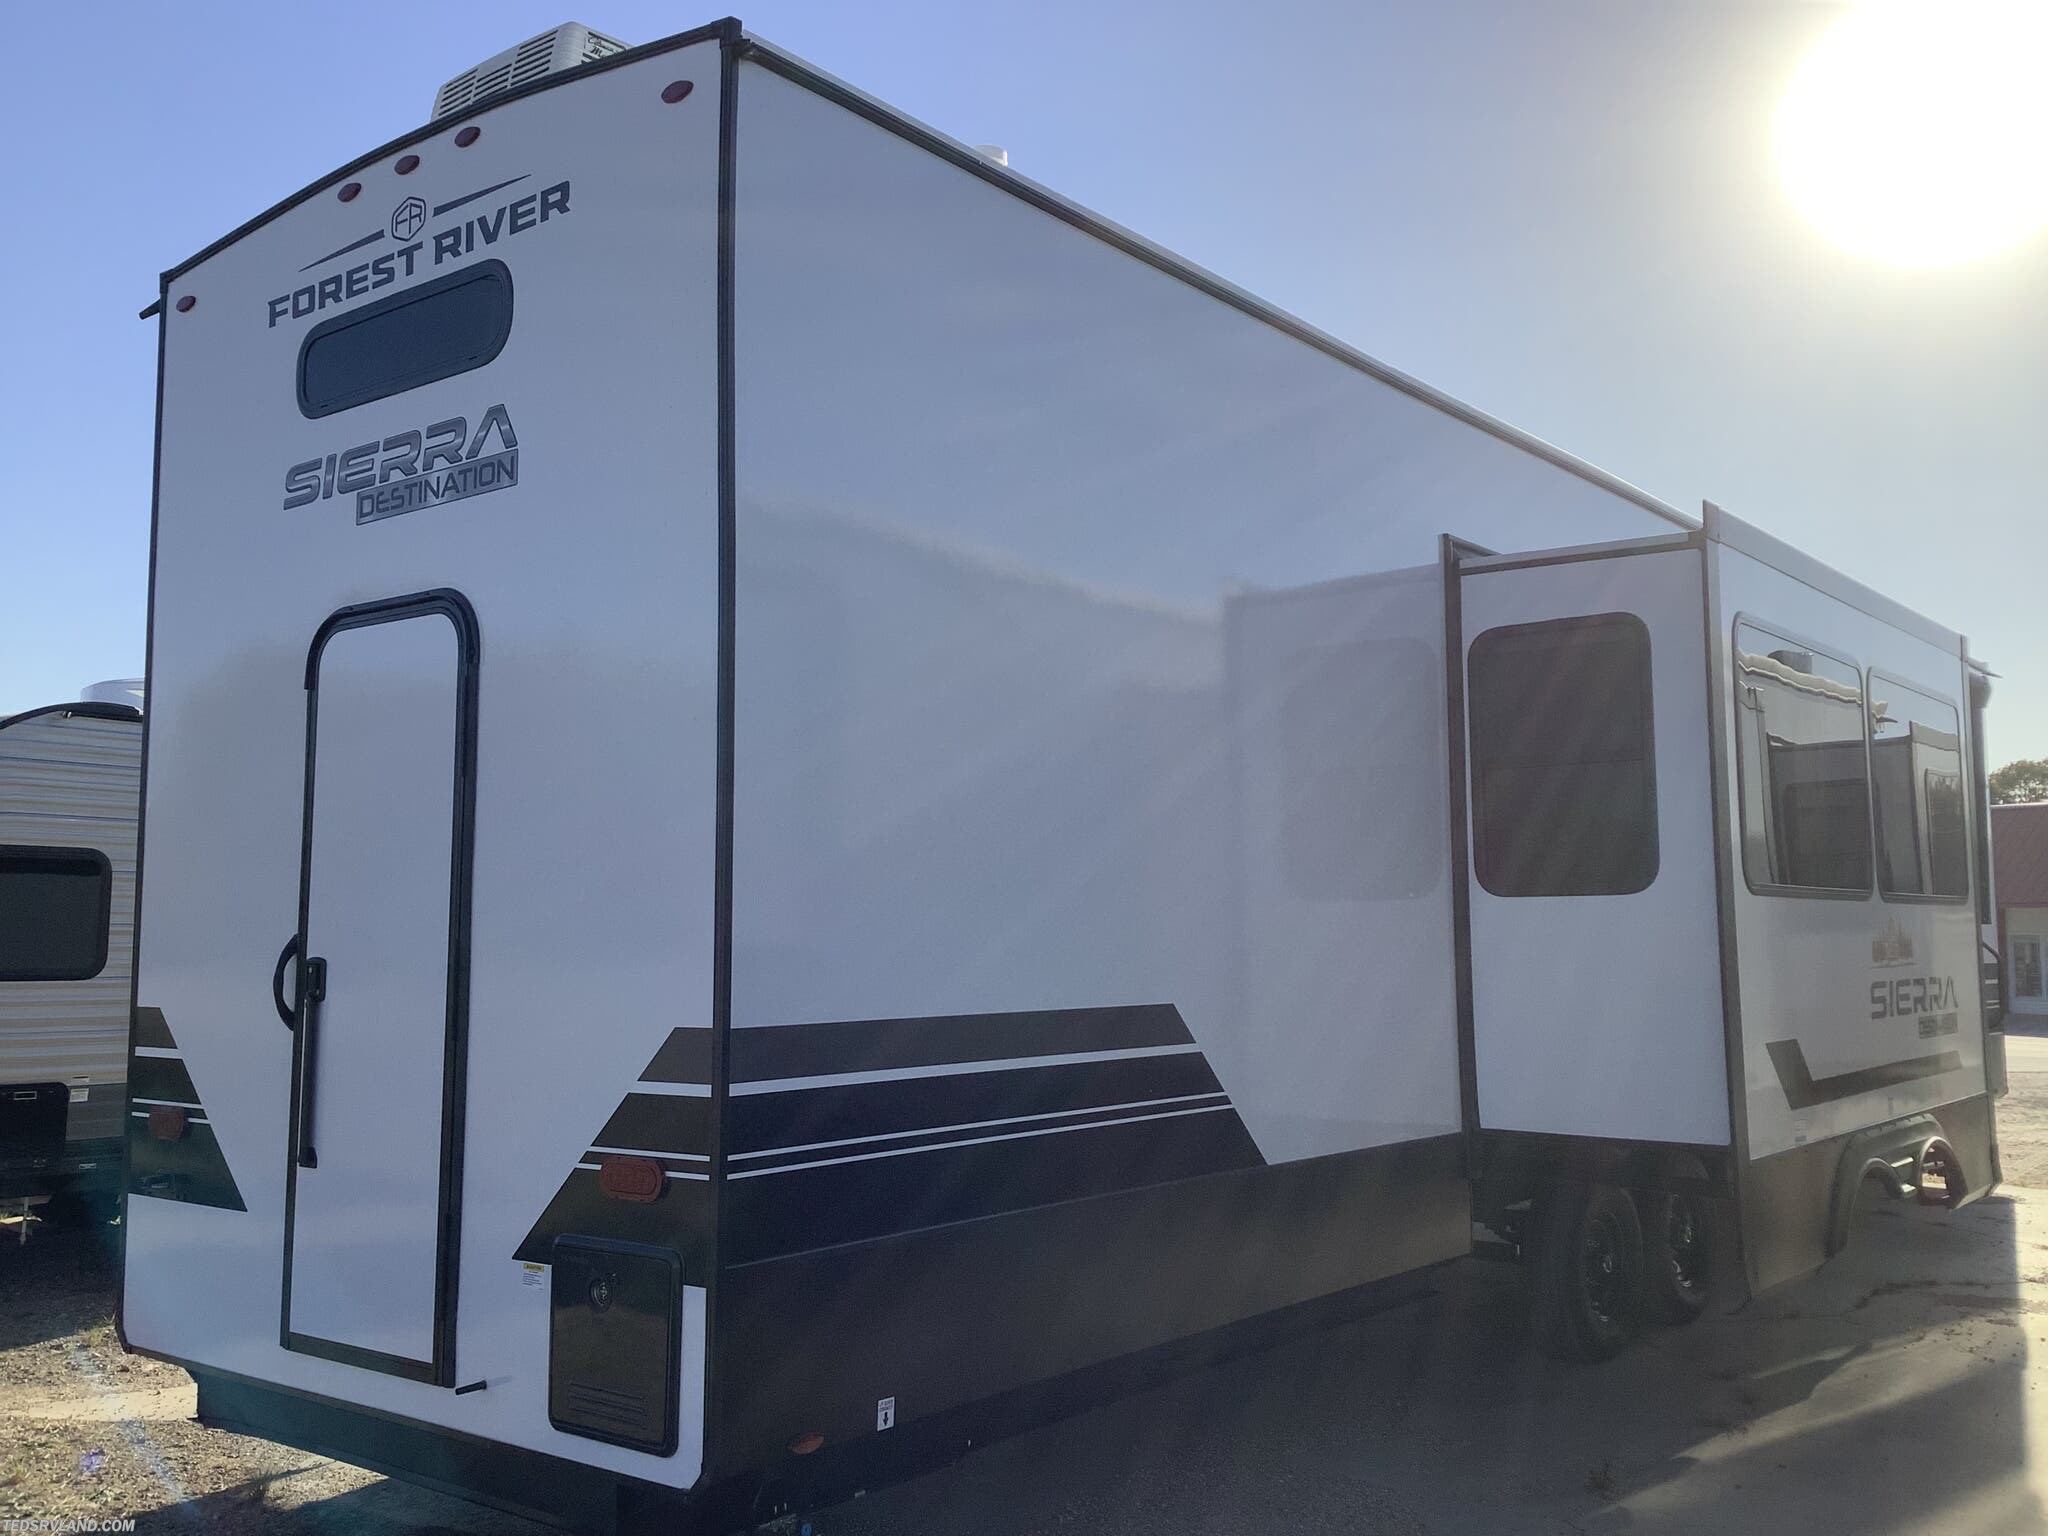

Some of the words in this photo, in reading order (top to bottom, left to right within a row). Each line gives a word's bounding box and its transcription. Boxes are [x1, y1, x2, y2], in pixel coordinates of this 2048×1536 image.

[267, 241, 424, 328] FOREST
[433, 180, 571, 266] RIVER
[283, 403, 519, 511] SIERRA
[358, 452, 517, 522] DESTINATION
[1871, 975, 1959, 1020] SIERRA
